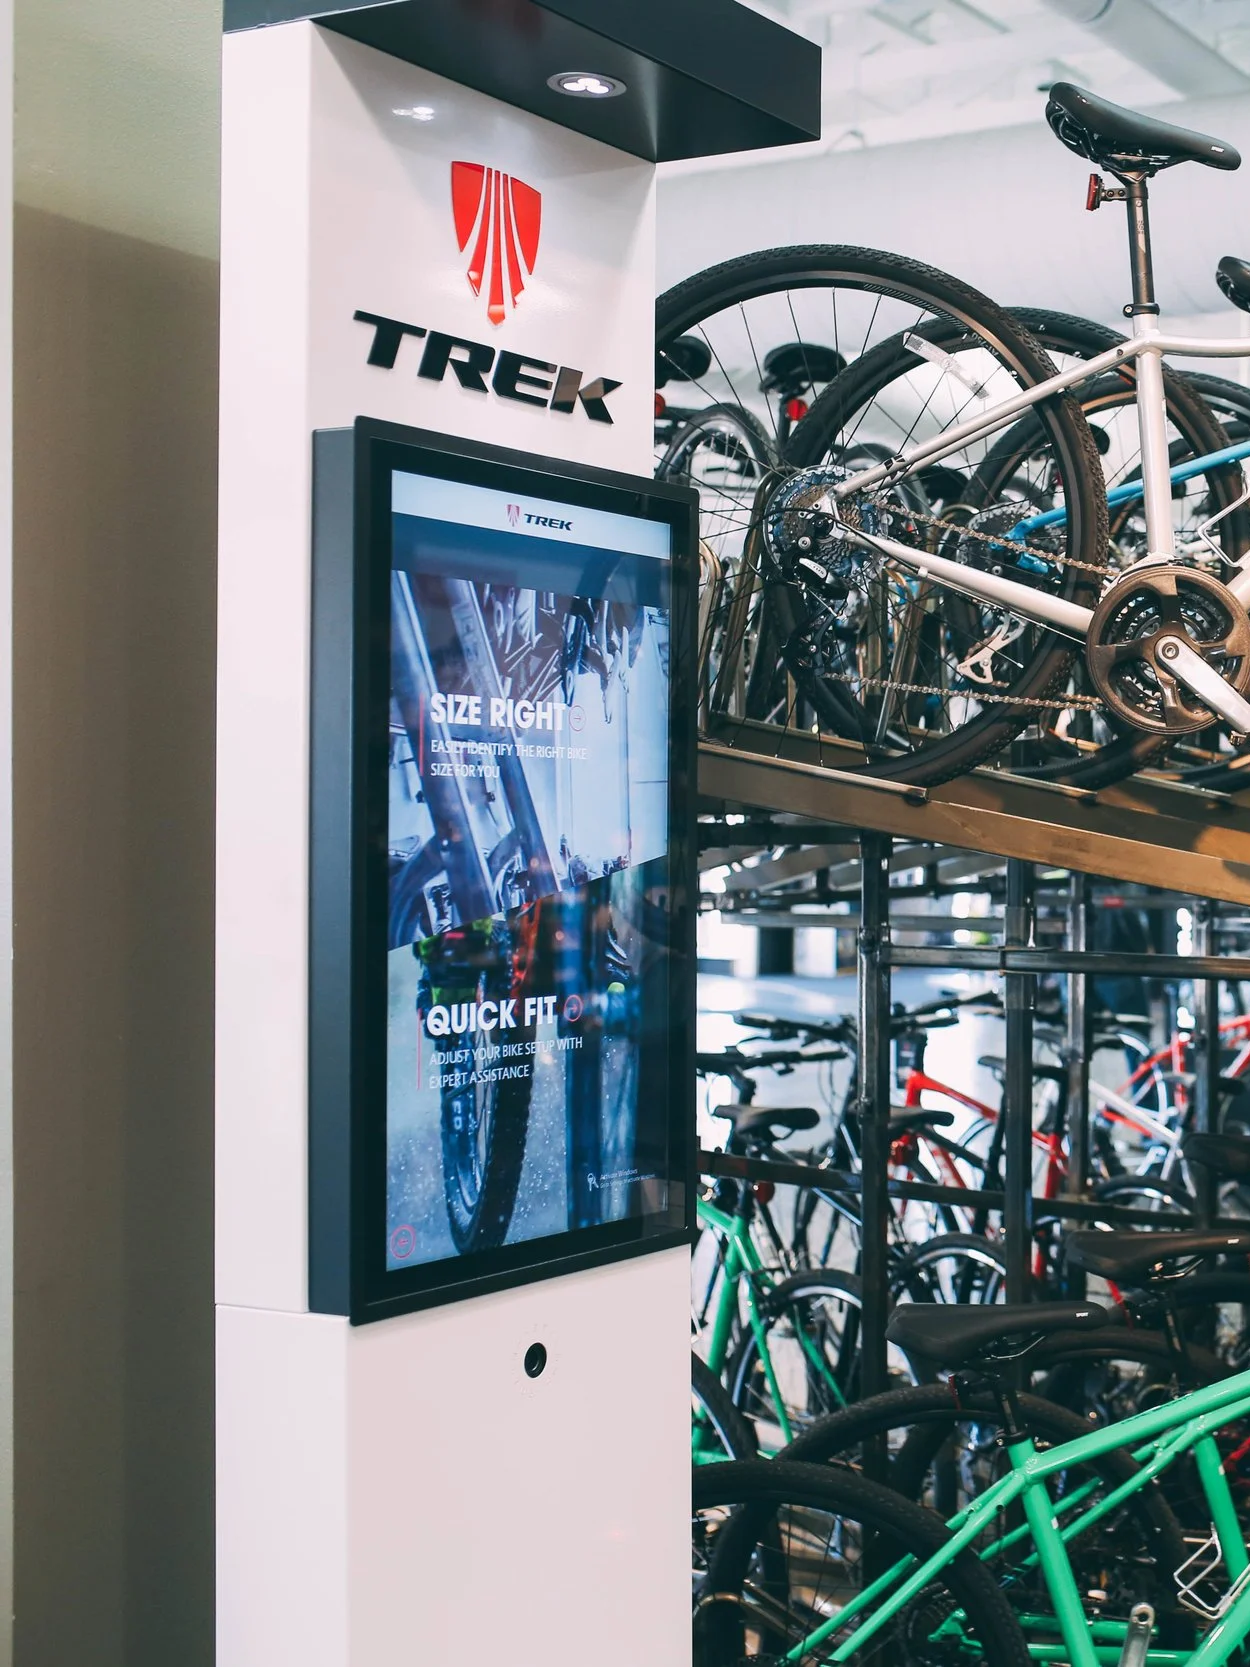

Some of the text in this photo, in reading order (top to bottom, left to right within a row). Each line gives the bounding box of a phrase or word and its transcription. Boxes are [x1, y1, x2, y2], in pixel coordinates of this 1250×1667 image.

[353, 309, 624, 425] TREK
[524, 513, 573, 531] TREK
[430, 693, 566, 731] SIZE RIGHT
[467, 741, 513, 757] IDENTIFY
[515, 744, 535, 758] THE
[536, 745, 564, 759] RIGHT
[567, 747, 588, 760] BIKE
[431, 763, 500, 779] SIZE FOR YOU
[427, 996, 557, 1036] QUICK FIT
[429, 1037, 583, 1066] ADJUST YOUR BIKE SETUP WITH
[429, 1065, 530, 1089] EXPERT ASSISTANCE
